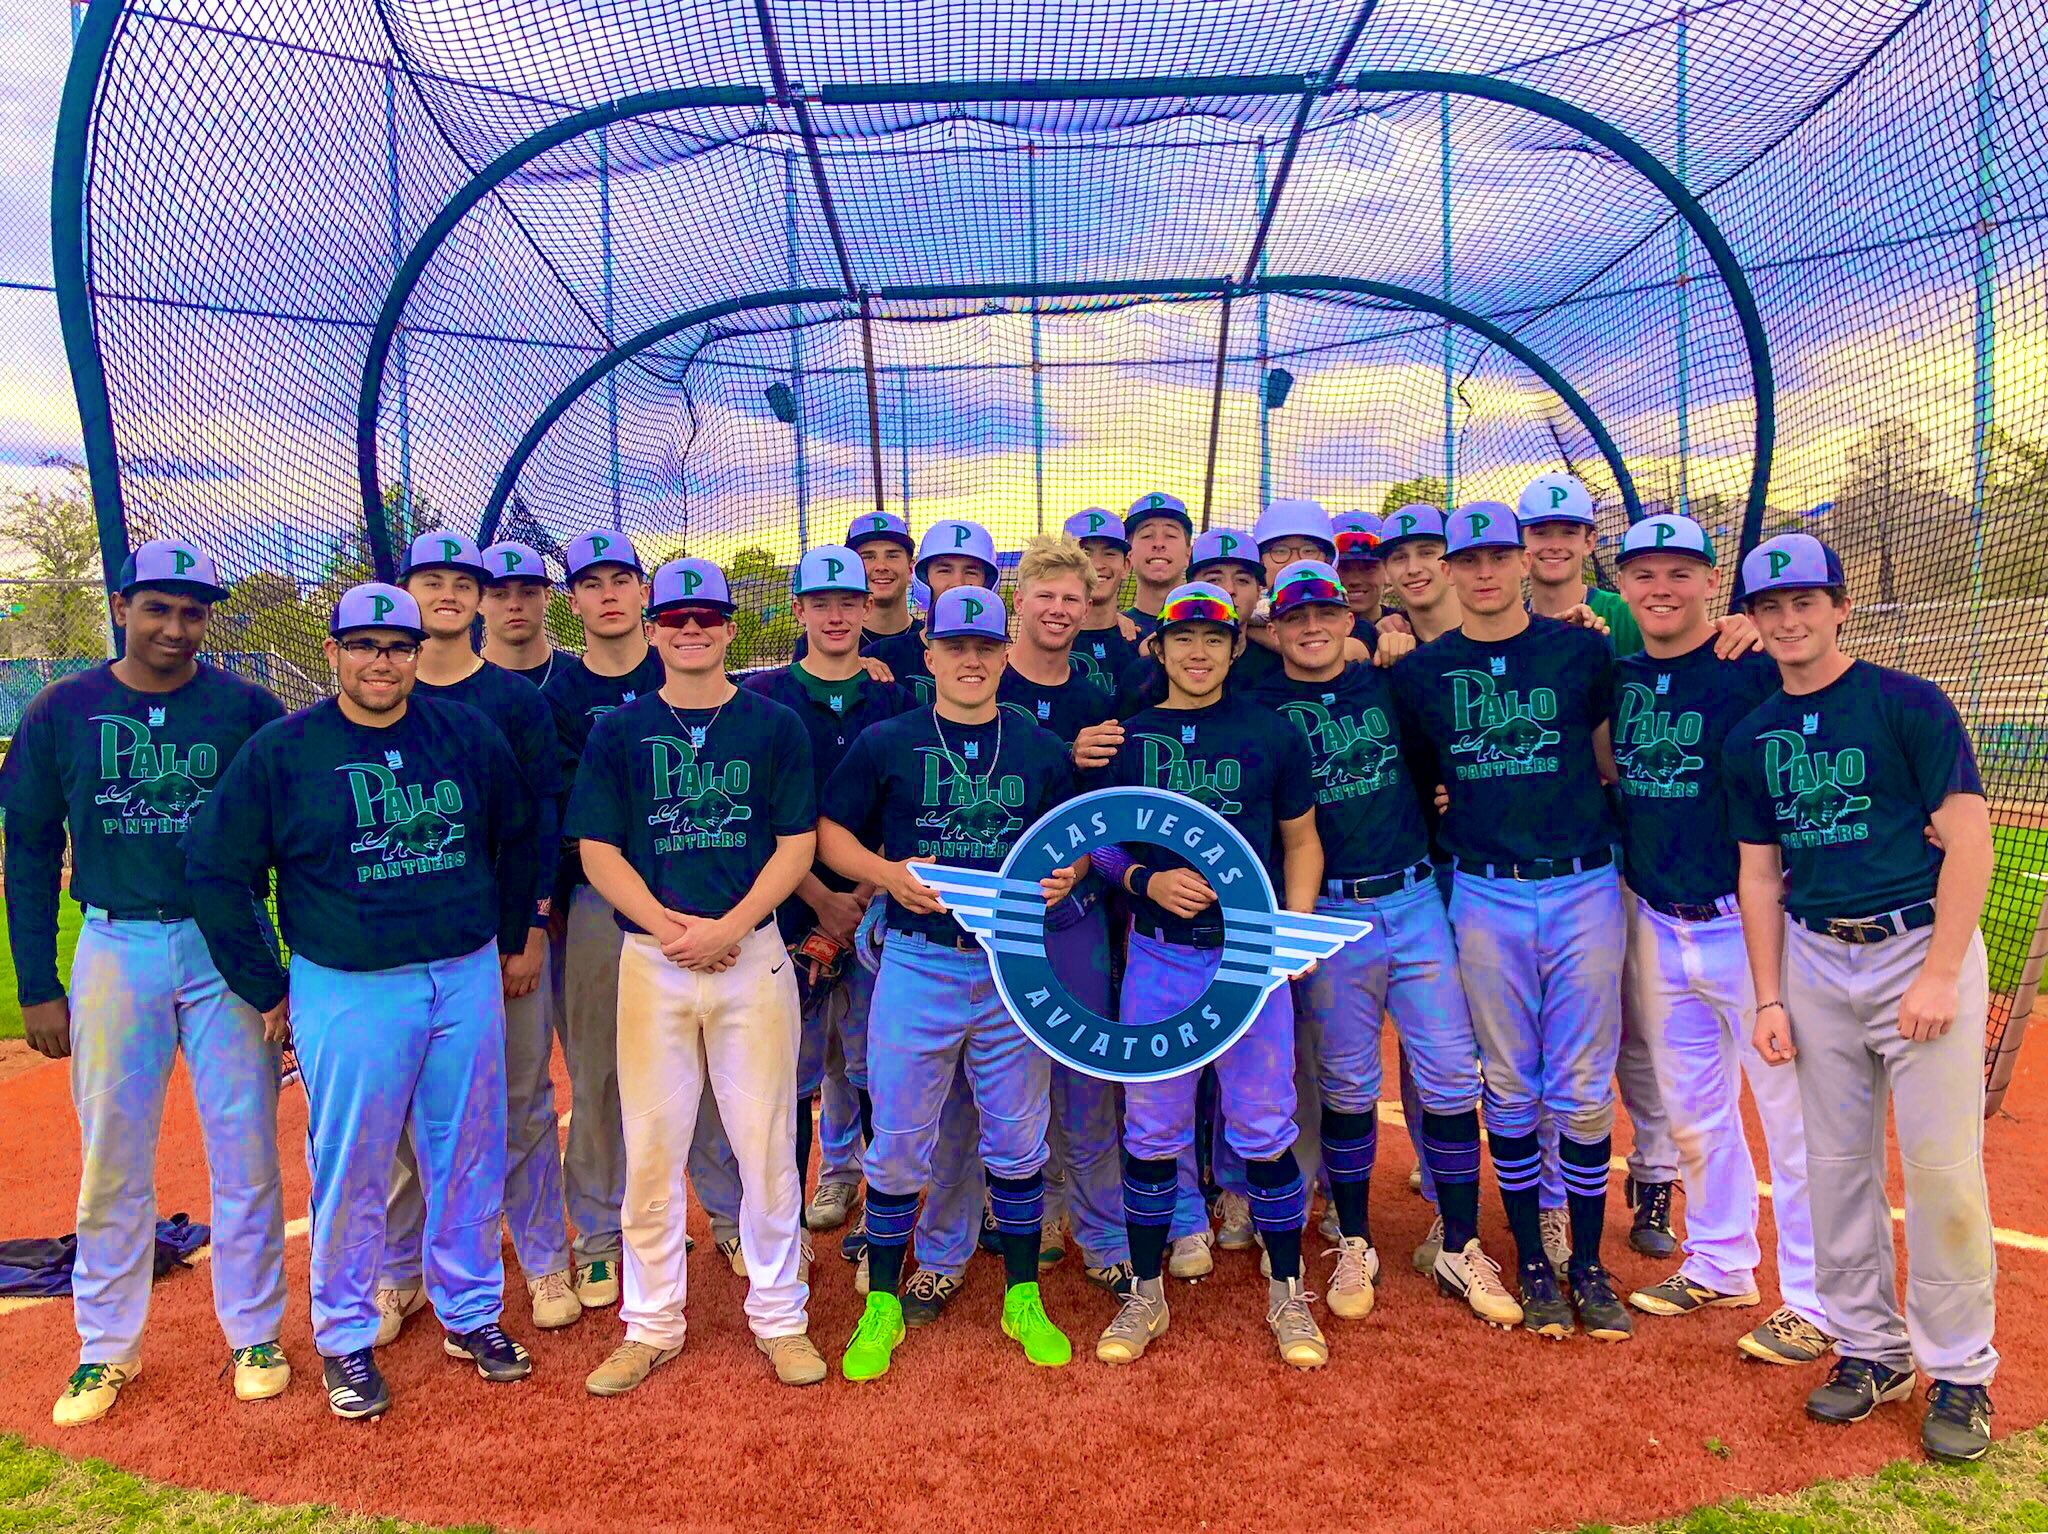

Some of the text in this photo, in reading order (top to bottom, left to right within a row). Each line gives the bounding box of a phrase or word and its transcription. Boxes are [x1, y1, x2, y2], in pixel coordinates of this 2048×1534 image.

[1548, 486, 1568, 508] P
[1086, 513, 1105, 532] P
[1395, 514, 1416, 537] P
[1464, 512, 1490, 538] P
[1648, 523, 1675, 548] P
[584, 535, 609, 557] P
[950, 525, 971, 548] P
[1216, 534, 1238, 557] P
[167, 550, 195, 575] P
[436, 540, 461, 562] P
[498, 551, 522, 572] P
[821, 558, 844, 581] P
[1762, 550, 1791, 579] P
[676, 570, 702, 596] P
[367, 595, 394, 621] P
[959, 598, 983, 624] P
[1441, 669, 1556, 731] PALO
[1614, 682, 1702, 745] PALO
[88, 714, 217, 779] PALO
[641, 735, 750, 800] PALO
[1132, 733, 1240, 791] PALO
[1456, 757, 1558, 780] PANTHERS
[1755, 729, 1865, 797] PALO
[913, 746, 1024, 806] PALO
[334, 762, 463, 827] PALO
[1042, 808, 1244, 885] LAS VEGAS
[357, 850, 466, 882] PANTHERS
[1024, 986, 1221, 1060] AVIATORS
